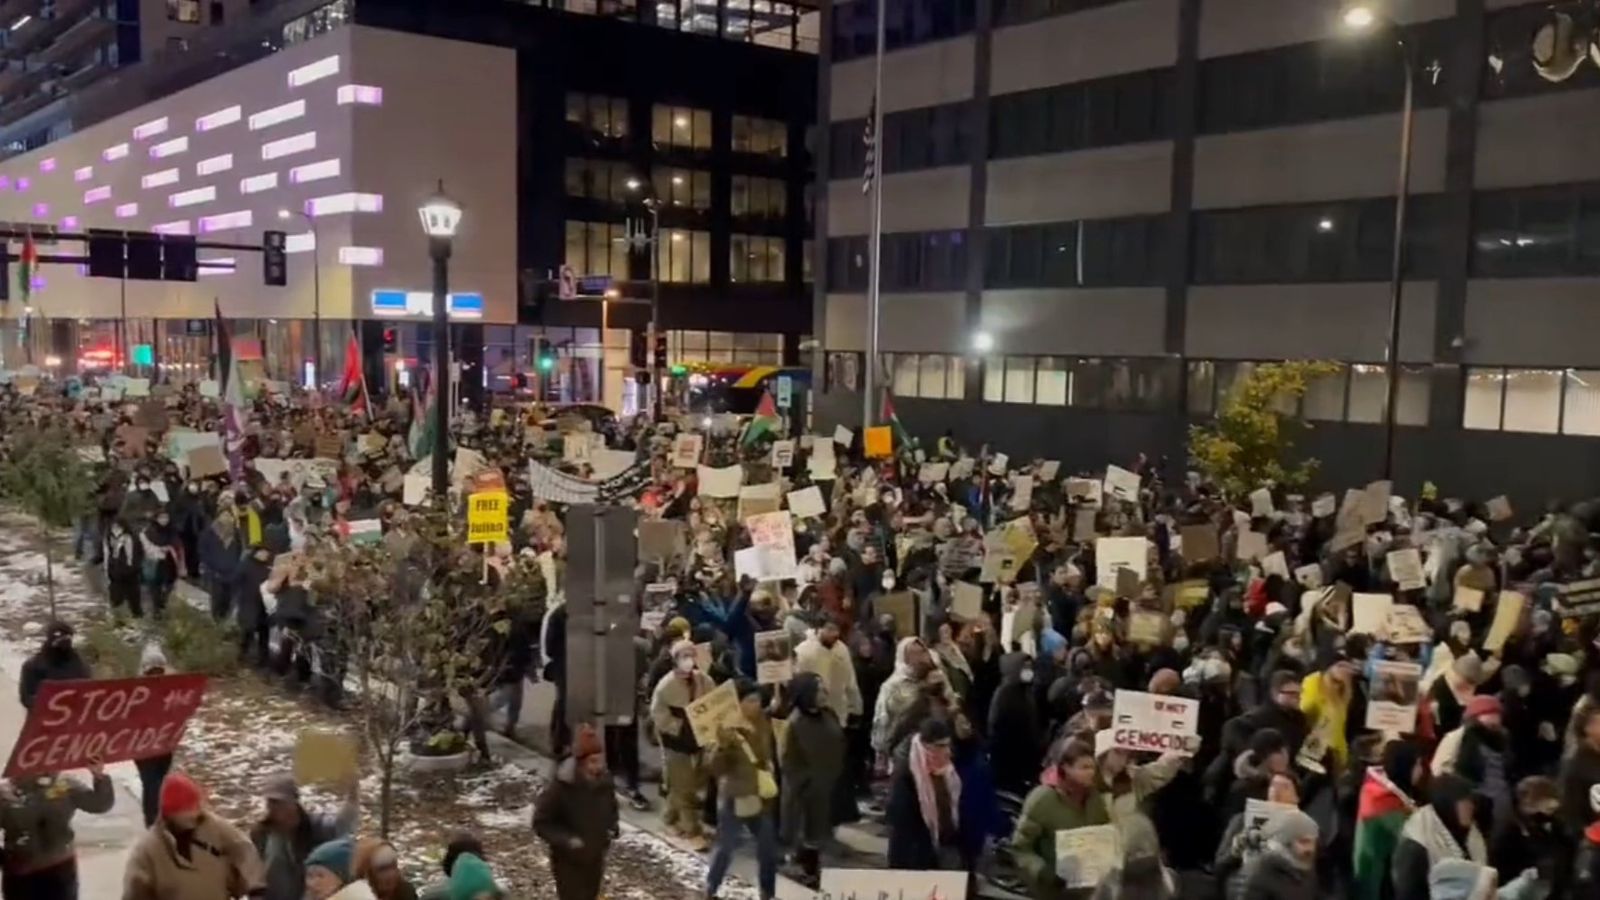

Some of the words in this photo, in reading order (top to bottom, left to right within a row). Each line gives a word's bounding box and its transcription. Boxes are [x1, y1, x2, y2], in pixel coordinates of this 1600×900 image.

[476, 498, 500, 512] FREE
[43, 685, 151, 726] STOP
[163, 688, 197, 711] the
[1115, 729, 1194, 752] GENOCIDE
